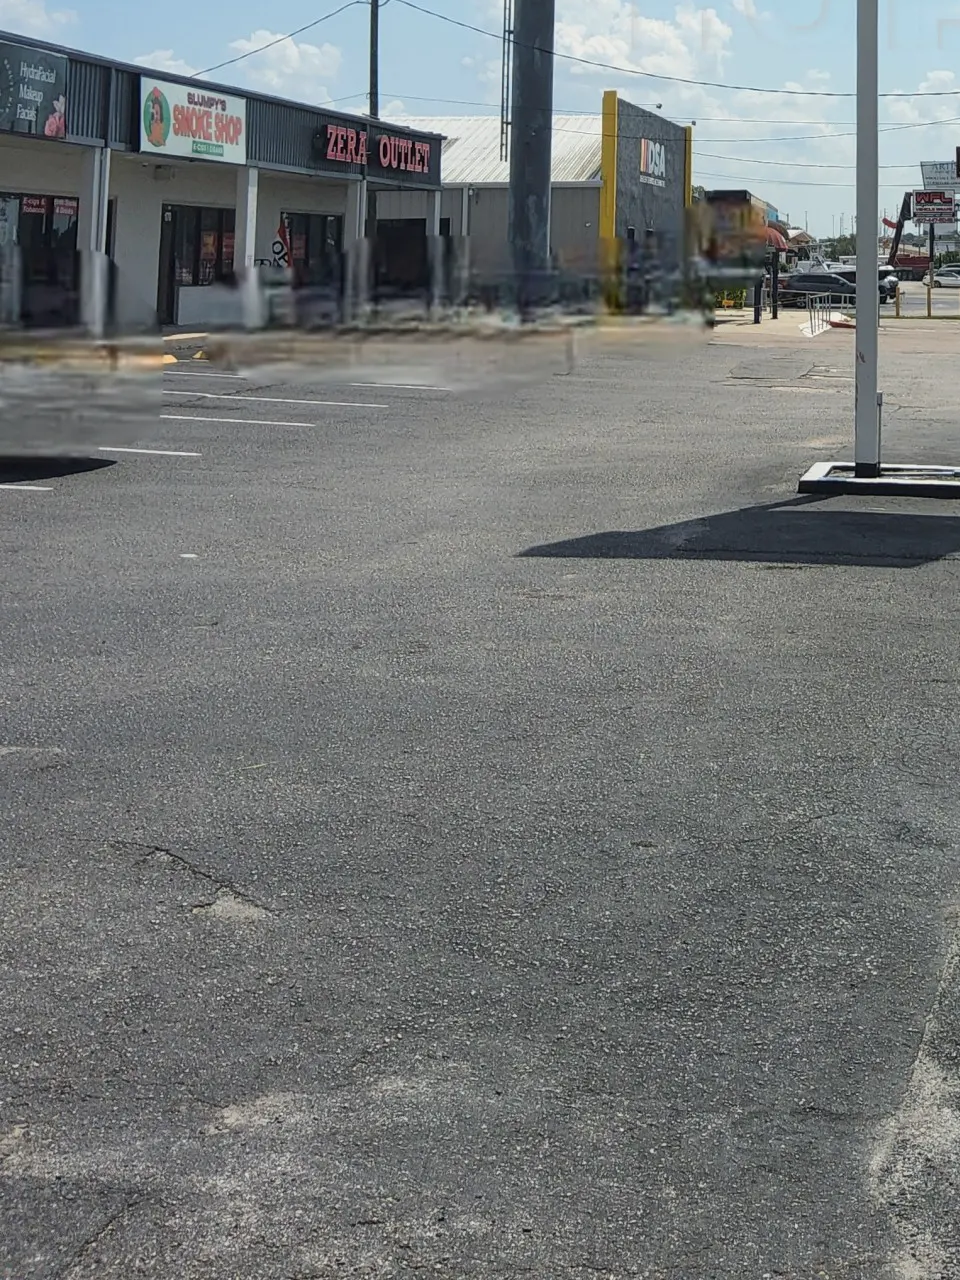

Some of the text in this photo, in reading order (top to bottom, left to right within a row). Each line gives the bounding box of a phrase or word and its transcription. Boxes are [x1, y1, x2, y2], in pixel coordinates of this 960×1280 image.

[20, 62, 56, 83] HydraFacial
[19, 84, 43, 106] Makeup
[187, 92, 226, 112] SLUMPY'S
[16, 104, 37, 120] Facials
[172, 104, 242, 145] SMOKE SHOP
[327, 125, 430, 173] ZERA OUTLET
[916, 192, 953, 204] WFL
